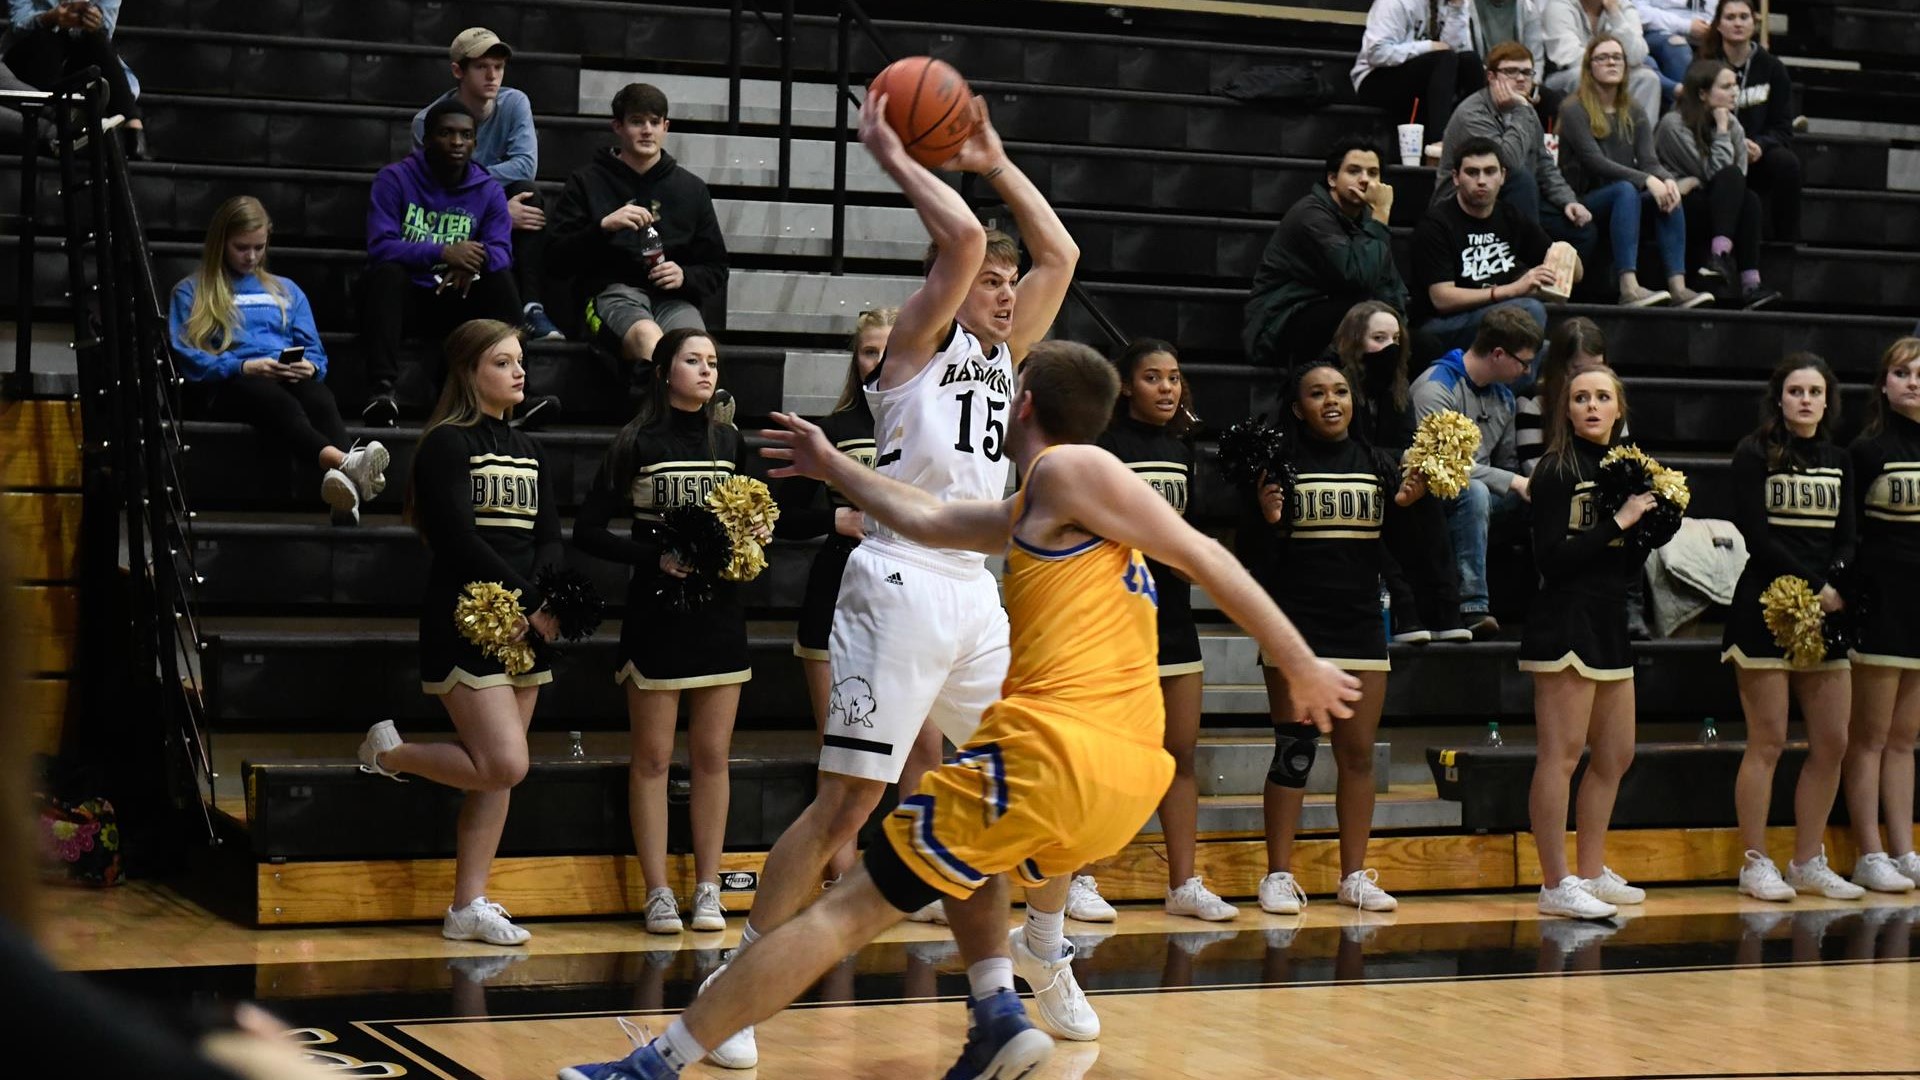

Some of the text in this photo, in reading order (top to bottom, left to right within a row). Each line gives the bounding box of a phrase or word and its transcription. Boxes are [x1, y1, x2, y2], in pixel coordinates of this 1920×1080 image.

[404, 202, 472, 234] FASTER
[1461, 255, 1516, 281] BLACK
[1462, 242, 1510, 262] CODE
[954, 390, 1005, 462] 15
[1293, 488, 1383, 522] BISONS
